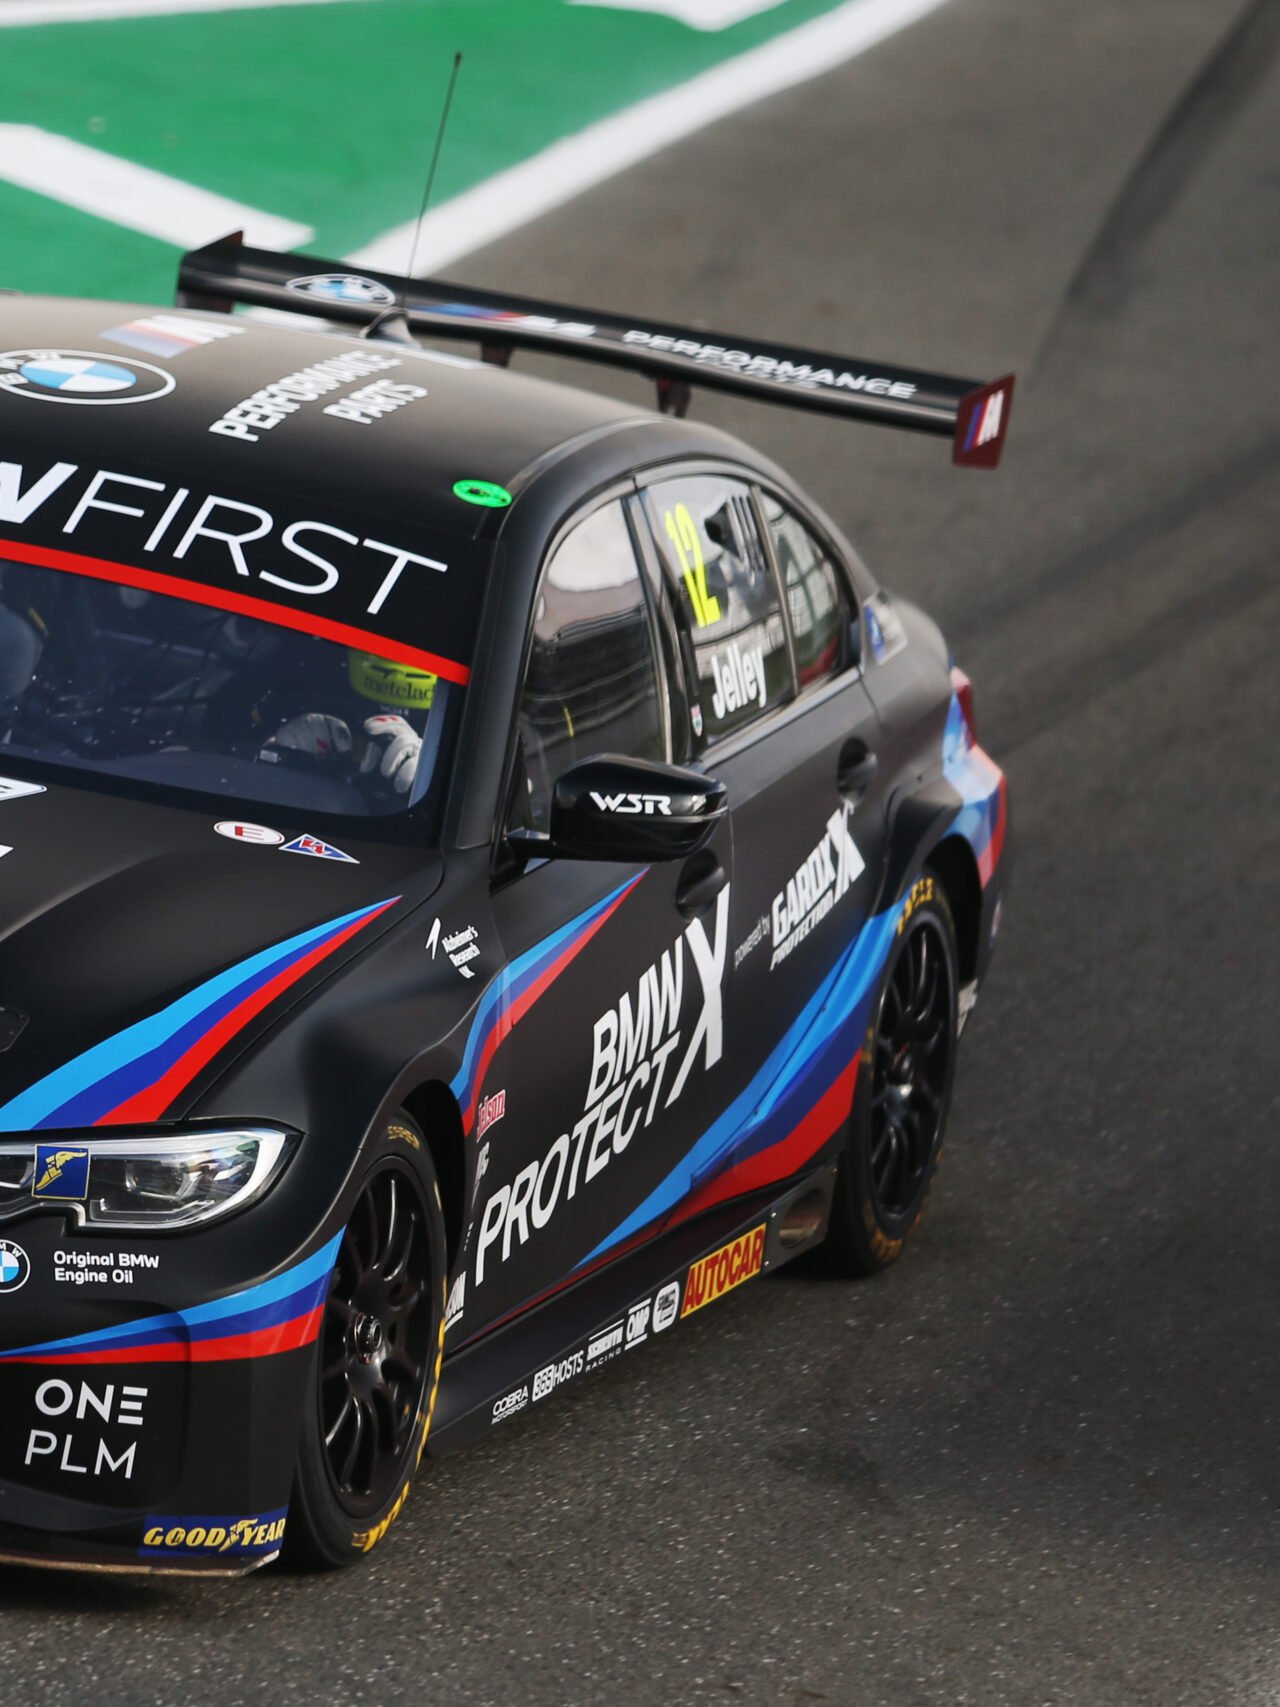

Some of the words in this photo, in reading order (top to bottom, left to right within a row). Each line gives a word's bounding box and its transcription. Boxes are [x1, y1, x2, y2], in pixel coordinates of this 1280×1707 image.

[622, 328, 918, 400] PERFORMANCE
[208, 348, 404, 443] PERFORMANCE
[322, 378, 429, 425] PARTS
[663, 501, 722, 629] 12
[709, 642, 768, 720] Jelley
[588, 790, 673, 816] WSR
[584, 932, 685, 1113] BMW
[473, 1027, 680, 1288] PROTECT
[53, 1250, 116, 1269] Original
[118, 1252, 160, 1270] BMW
[53, 1266, 108, 1285] Engine
[110, 1268, 134, 1285] Oil
[681, 1226, 765, 1316] AUTOCAR
[625, 1304, 651, 1343] OMP
[584, 1346, 622, 1373] RACING
[33, 1377, 149, 1427] ONE
[492, 1384, 529, 1416] COBRA
[23, 1428, 138, 1480] PLM
